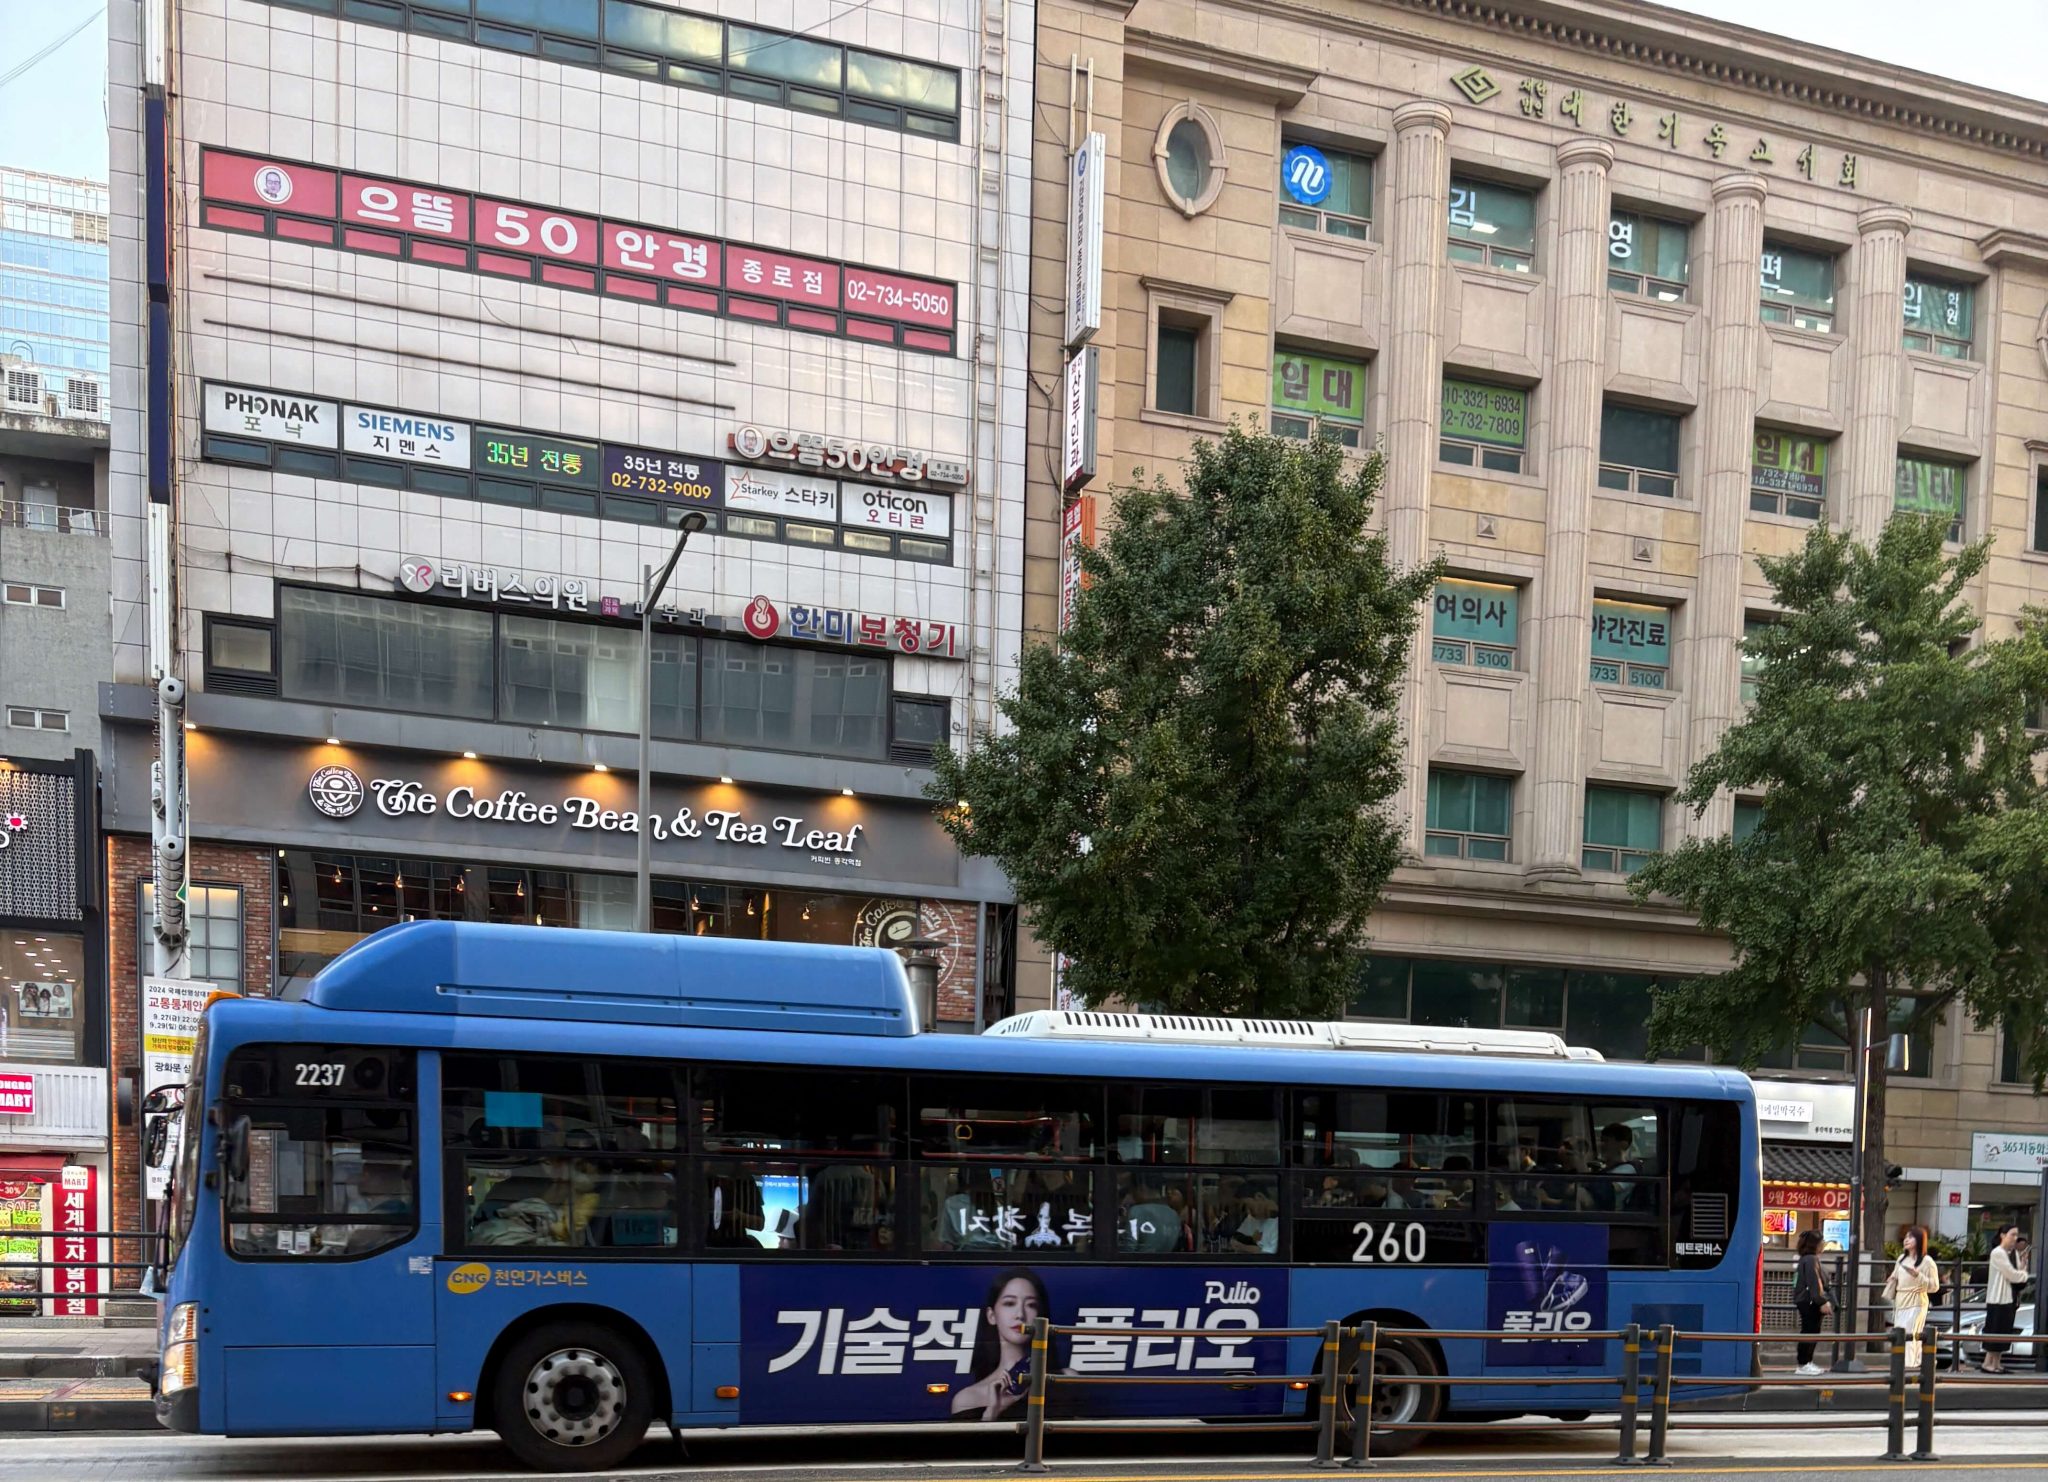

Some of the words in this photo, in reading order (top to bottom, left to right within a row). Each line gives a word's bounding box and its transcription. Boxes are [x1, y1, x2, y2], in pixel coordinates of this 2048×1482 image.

[357, 186, 455, 234] 으뜸
[494, 207, 578, 255] 50
[615, 230, 707, 279] 안경
[742, 258, 823, 295] 종로점
[848, 279, 948, 315] 02-734-5050
[1609, 220, 1632, 258] 영
[1281, 360, 1354, 410] 임대
[224, 391, 320, 424] PHONAK
[244, 416, 303, 440] 포낙
[358, 412, 455, 442] SIEMENS
[373, 434, 441, 460] 지멘스
[487, 441, 529, 468] 35년
[541, 448, 583, 475] 전통
[768, 431, 924, 481] 으뜸50안경
[624, 455, 662, 475] 35년
[667, 460, 700, 481] 전통
[611, 472, 712, 499] 02-732-9009
[741, 483, 779, 500] Starkey
[785, 487, 834, 509] 스타키
[863, 489, 928, 515] oticon
[866, 508, 925, 530] 오티콘
[440, 564, 589, 612] 리버스의원
[1436, 594, 1507, 628] 여의사
[788, 605, 954, 657] 한미보청기
[1592, 615, 1666, 647] 야간진료
[1477, 651, 1509, 667] 5100
[1631, 670, 1661, 686] 5100
[370, 779, 437, 816] The
[446, 786, 557, 825] Coffee
[563, 797, 668, 841] Bean
[671, 807, 702, 838] &
[704, 810, 768, 845] Tea
[772, 816, 863, 852] Leaf
[155, 1062, 181, 1073] 광화문
[295, 1064, 345, 1086] 2237
[1824, 1191, 1851, 1208] OP
[1352, 1222, 1426, 1262] 260
[1675, 1242, 1722, 1256] 메트로버스
[452, 1272, 488, 1285] CNG
[495, 1269, 588, 1287] 천연가스버스
[1205, 1280, 1261, 1305] Pulio
[1501, 1310, 1592, 1343] 풀리오
[768, 1308, 979, 1375] 기술적
[1069, 1308, 1260, 1372] 풀리오
